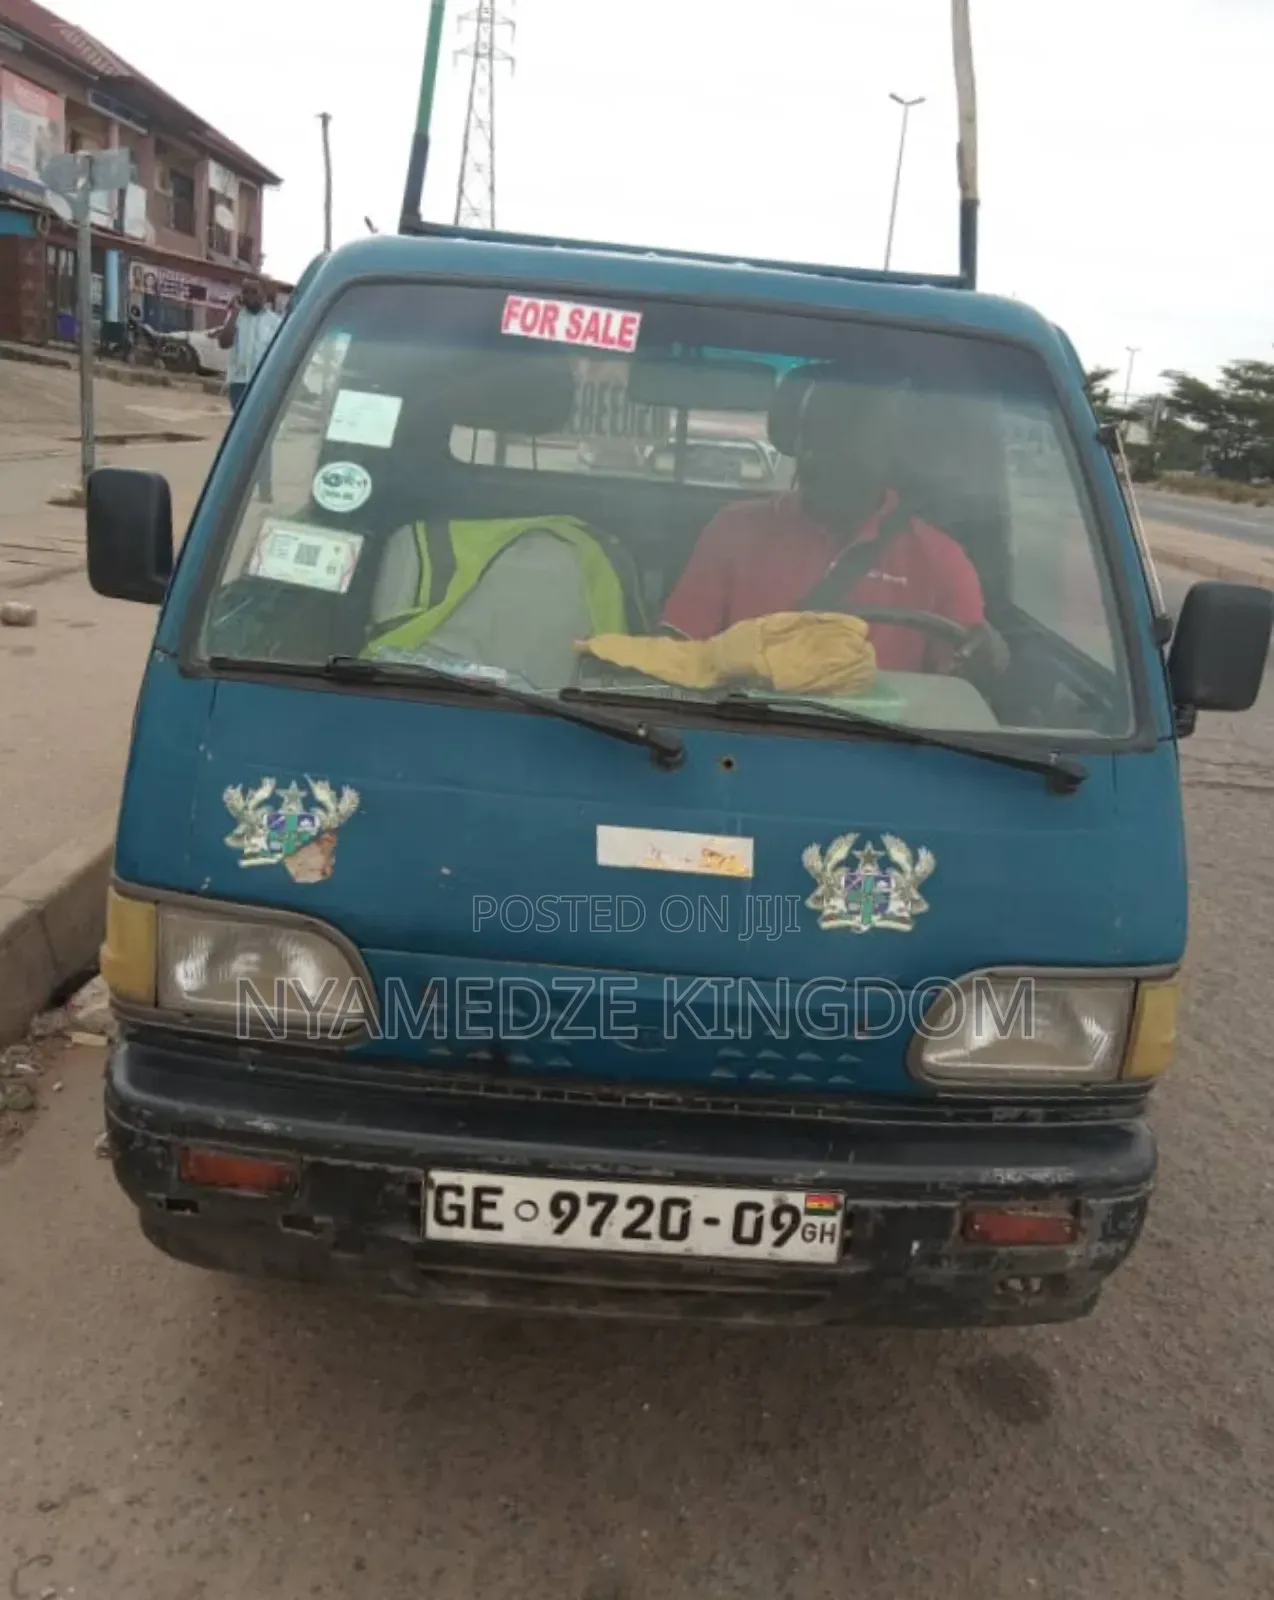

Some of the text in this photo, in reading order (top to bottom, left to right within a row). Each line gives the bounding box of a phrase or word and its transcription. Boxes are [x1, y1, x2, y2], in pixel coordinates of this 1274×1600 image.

[502, 299, 637, 348] FOR SALE
[432, 1184, 504, 1231] GE
[801, 1221, 837, 1245] GH
